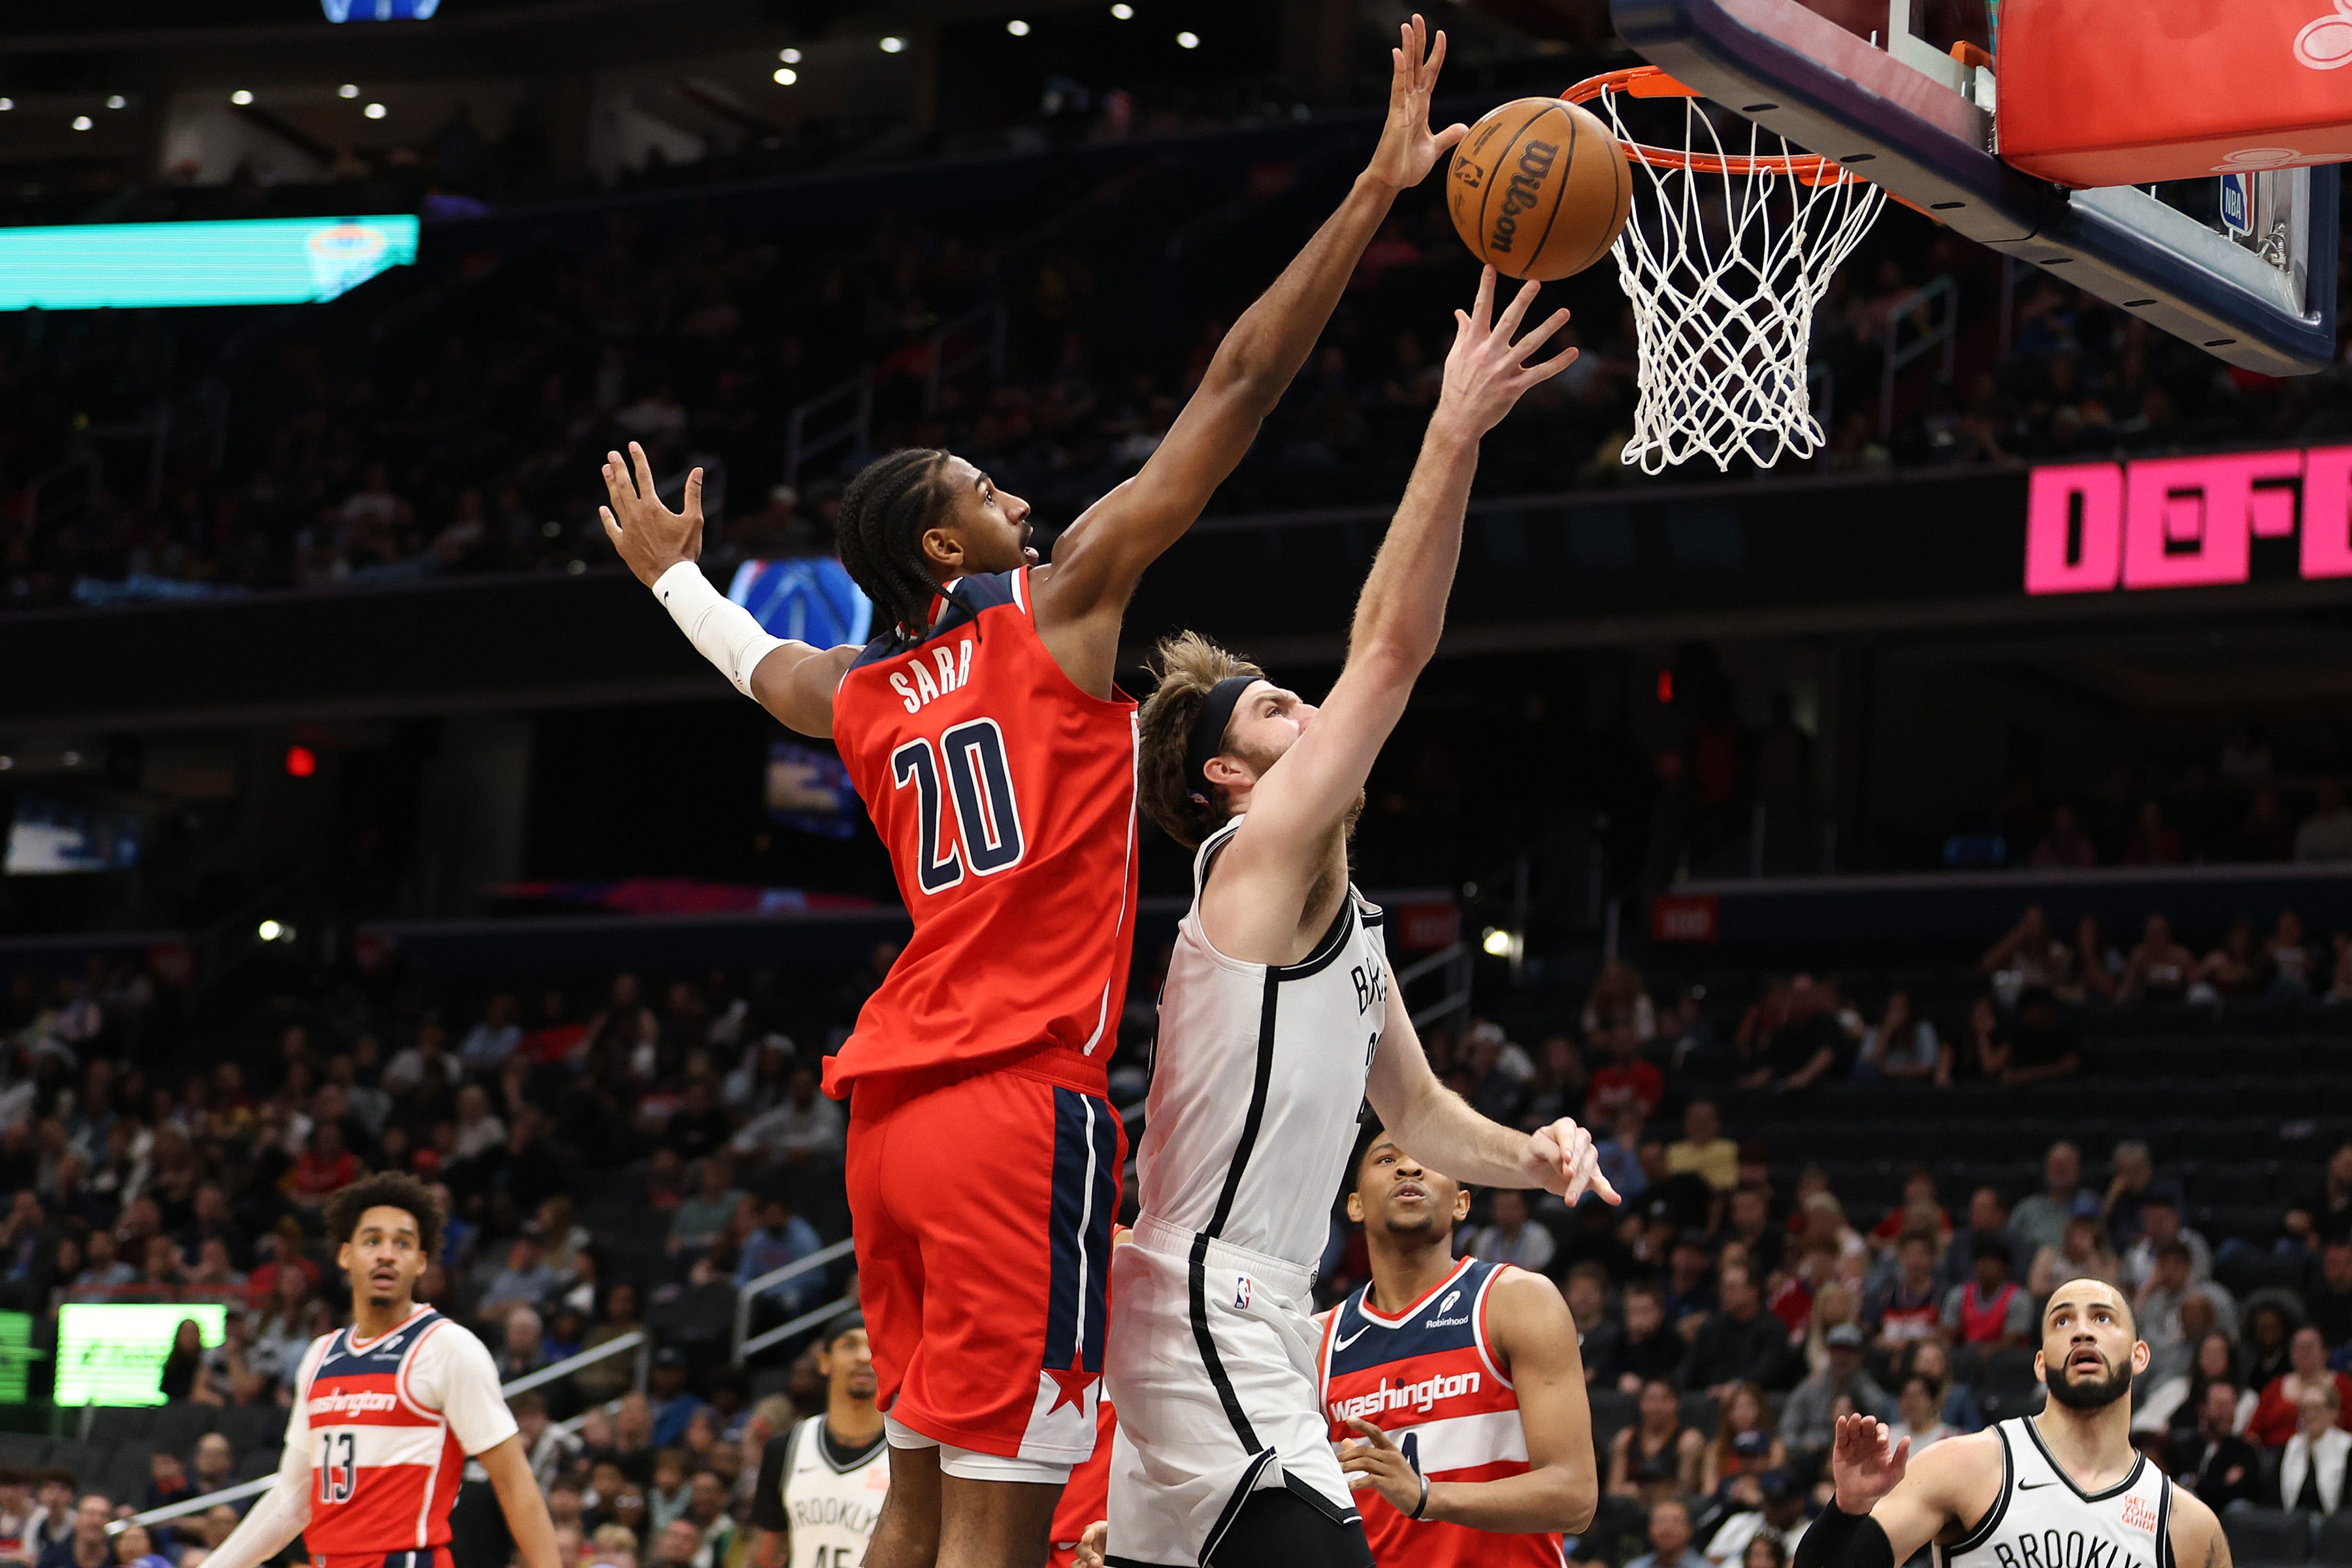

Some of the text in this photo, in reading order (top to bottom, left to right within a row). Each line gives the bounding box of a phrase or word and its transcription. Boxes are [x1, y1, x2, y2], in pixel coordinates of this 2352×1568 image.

[1490, 139, 1560, 253] Wilson
[2225, 186, 2242, 221] NBA
[889, 639, 973, 714] SARR
[890, 717, 1025, 896] 20
[1425, 1314, 1469, 1330] Robinhood
[1330, 1371, 1480, 1424] washington
[319, 1432, 357, 1505] 13
[2121, 1512, 2157, 1534] GUIDE
[2125, 1494, 2148, 1508] GET
[2125, 1503, 2157, 1522] YOUR
